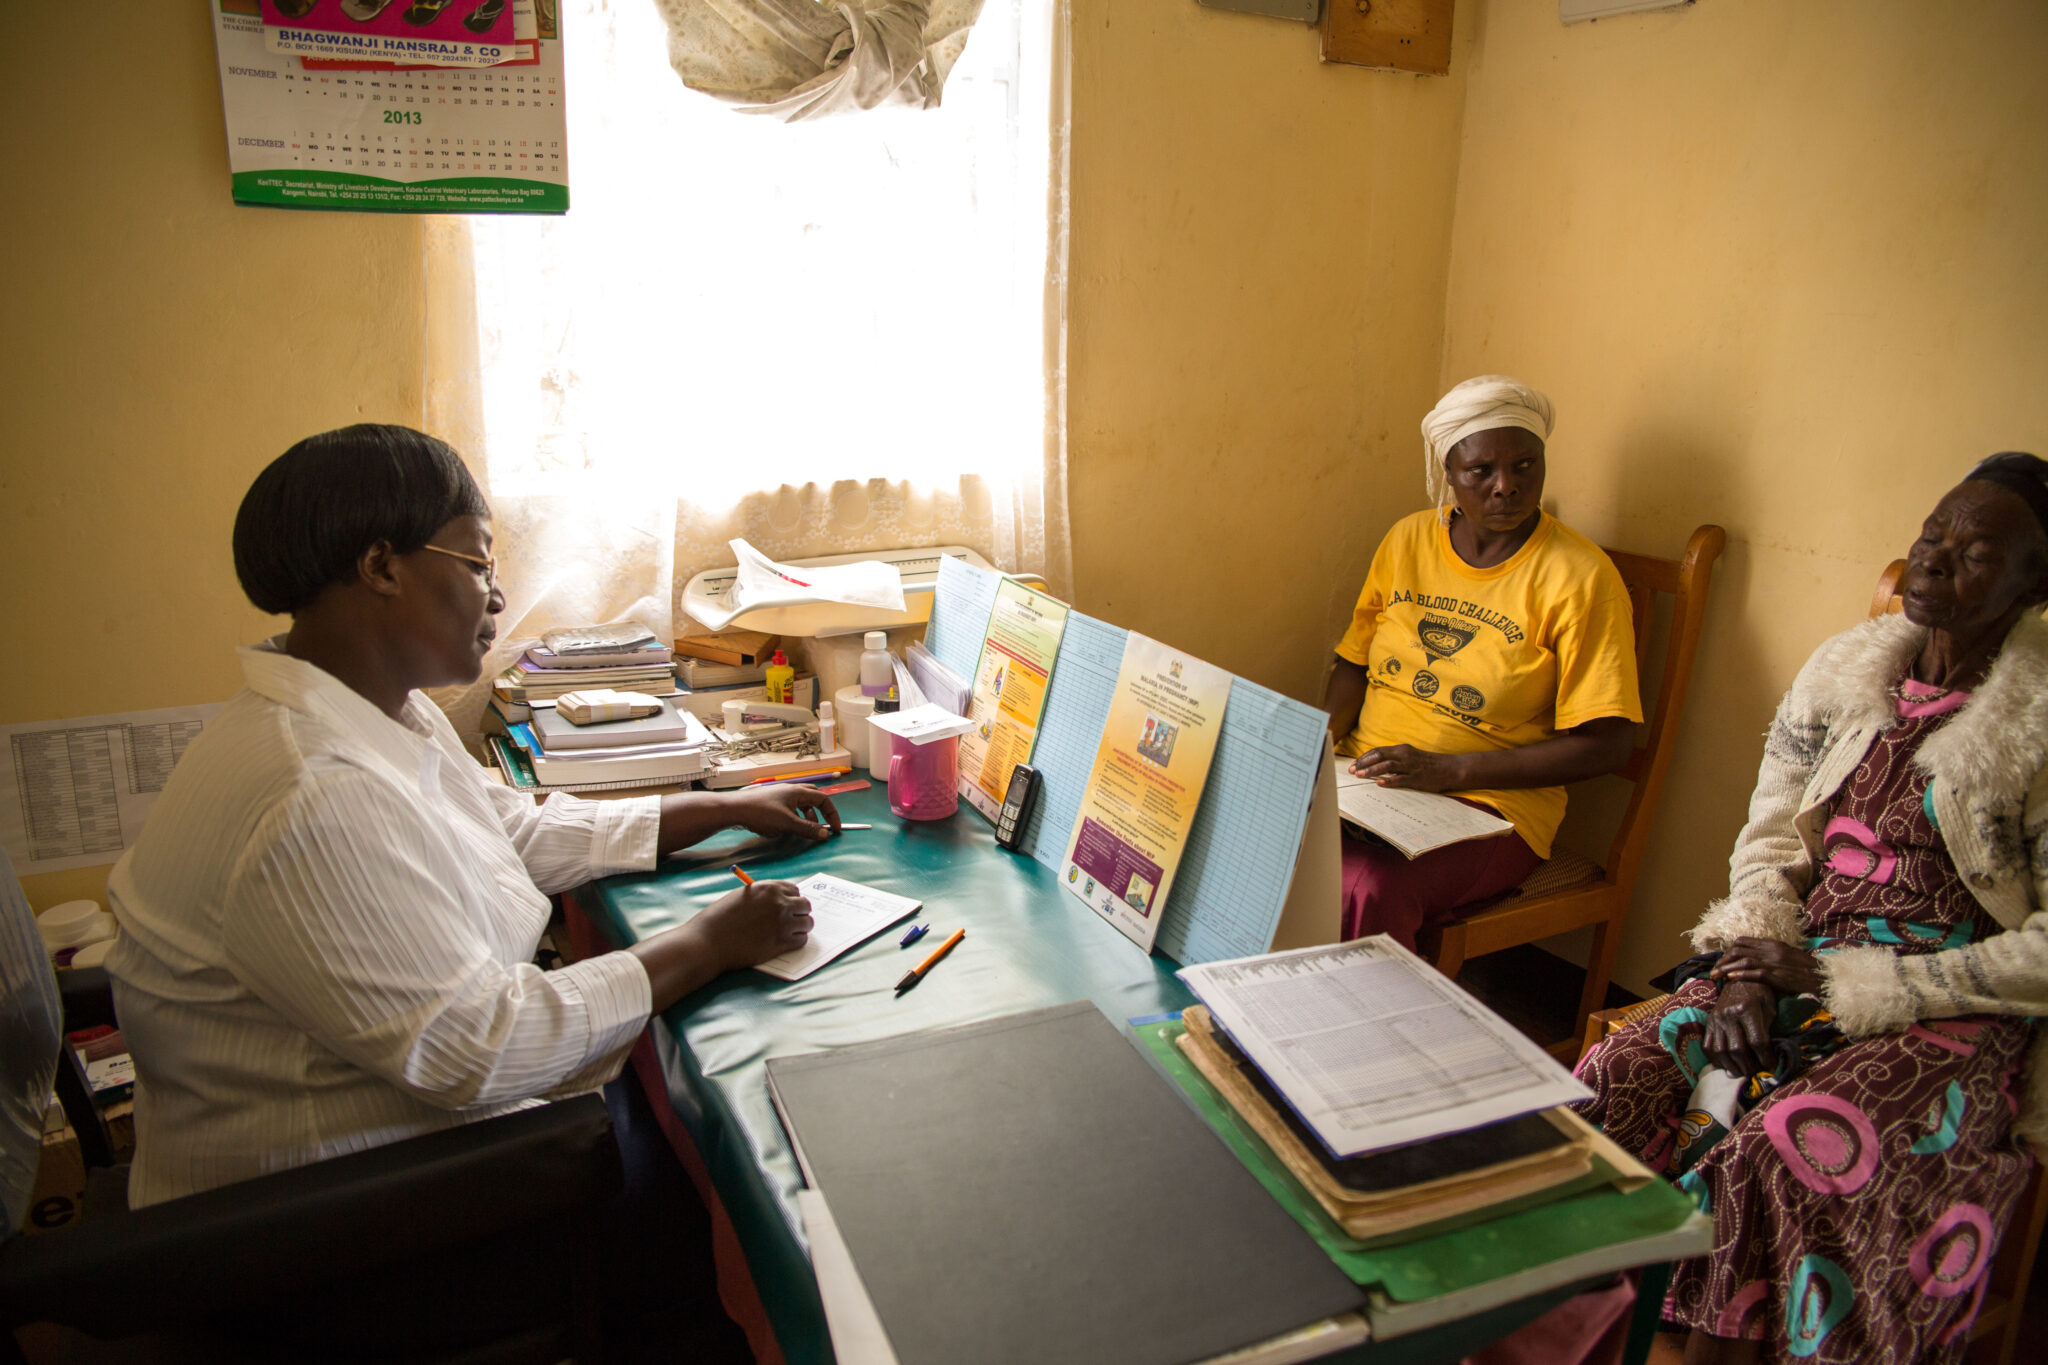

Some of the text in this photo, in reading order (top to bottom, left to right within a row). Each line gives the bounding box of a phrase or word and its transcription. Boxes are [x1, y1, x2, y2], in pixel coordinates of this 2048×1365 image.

[279, 30, 500, 57] BHAGWANJI HANSRAJ & CO
[336, 47, 367, 55] KISUMU
[370, 49, 402, 58] (KENYA)
[228, 66, 278, 79] NOVEMBER
[383, 110, 422, 125] 2013
[238, 137, 285, 148] DECEMBER
[316, 182, 337, 191] Ministry
[1417, 593, 1458, 612] BLOOD
[1458, 601, 1524, 644] CHALLENGE
[1425, 612, 1449, 626] Have
